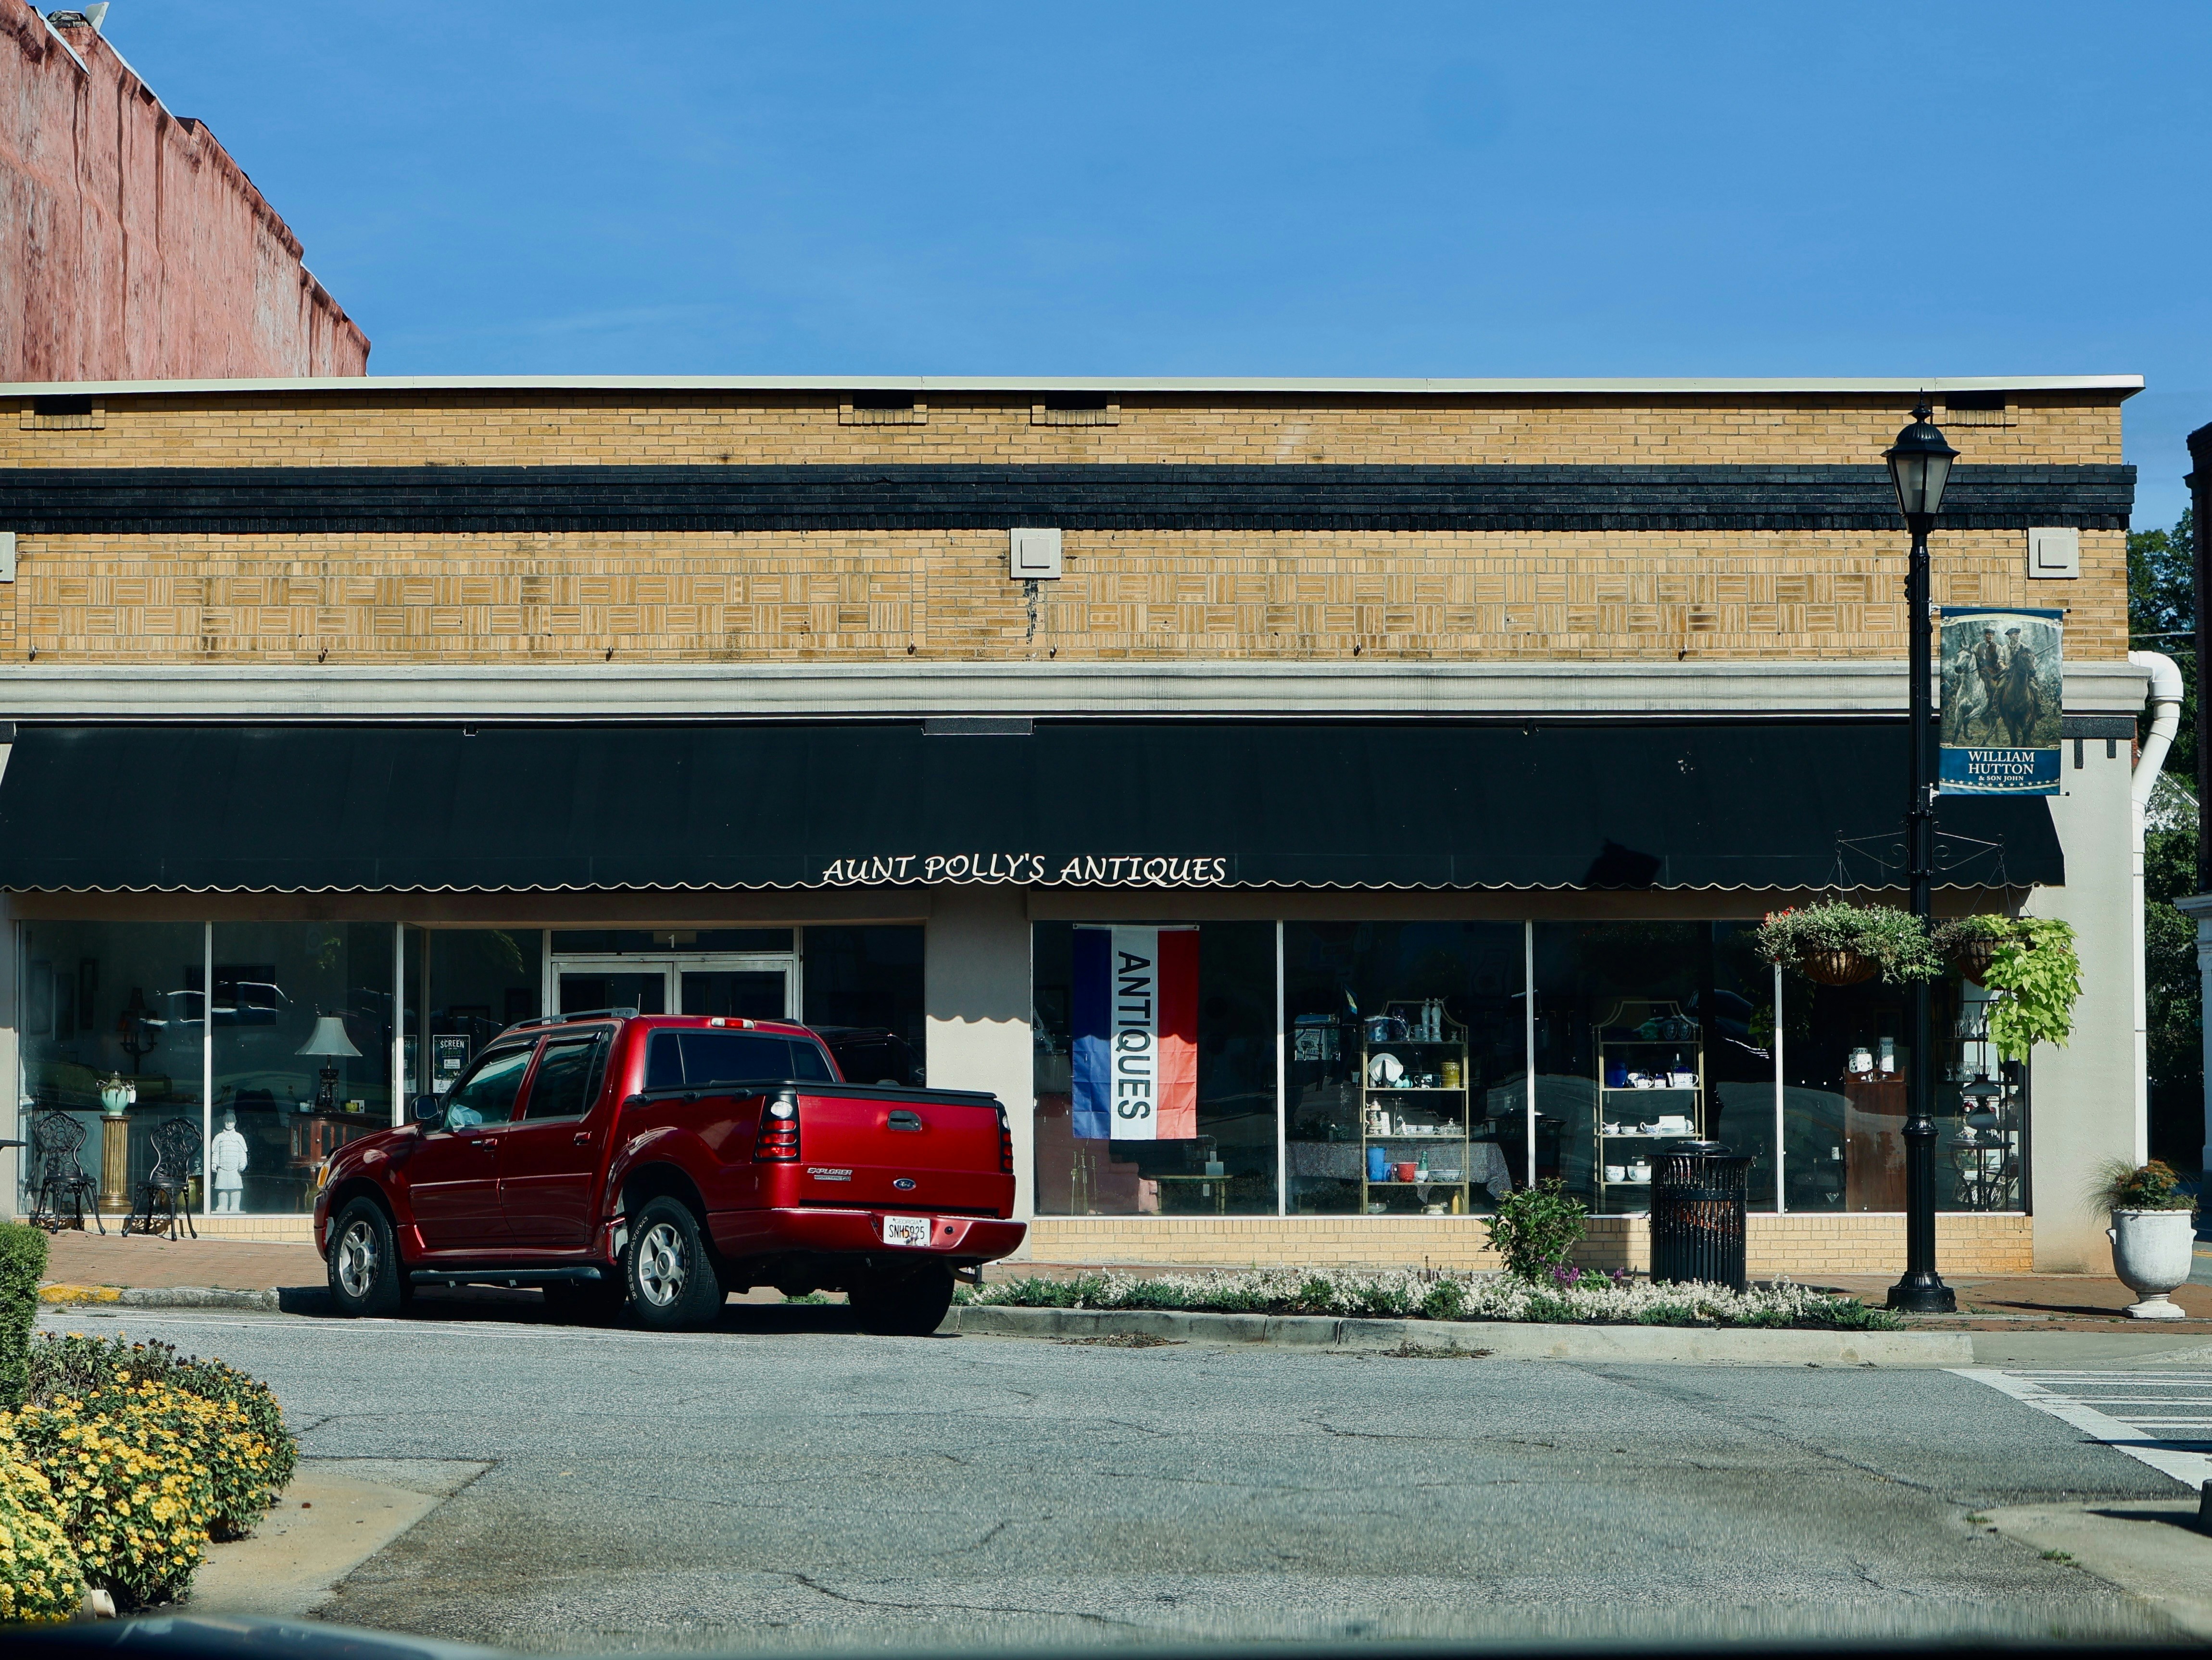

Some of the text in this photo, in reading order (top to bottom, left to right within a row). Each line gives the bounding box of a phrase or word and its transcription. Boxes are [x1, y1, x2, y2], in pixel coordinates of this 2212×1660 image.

[1968, 751, 2035, 762] WILLIAM
[1968, 763, 2034, 774] HUTTON
[822, 853, 1226, 885] AUNT POLLY'S ANTIQUES
[668, 934, 675, 949] 1
[1116, 950, 1151, 1120] ANTIQUES
[440, 1040, 465, 1048] SCREEN
[628, 1216, 648, 1300] DESTINATION
